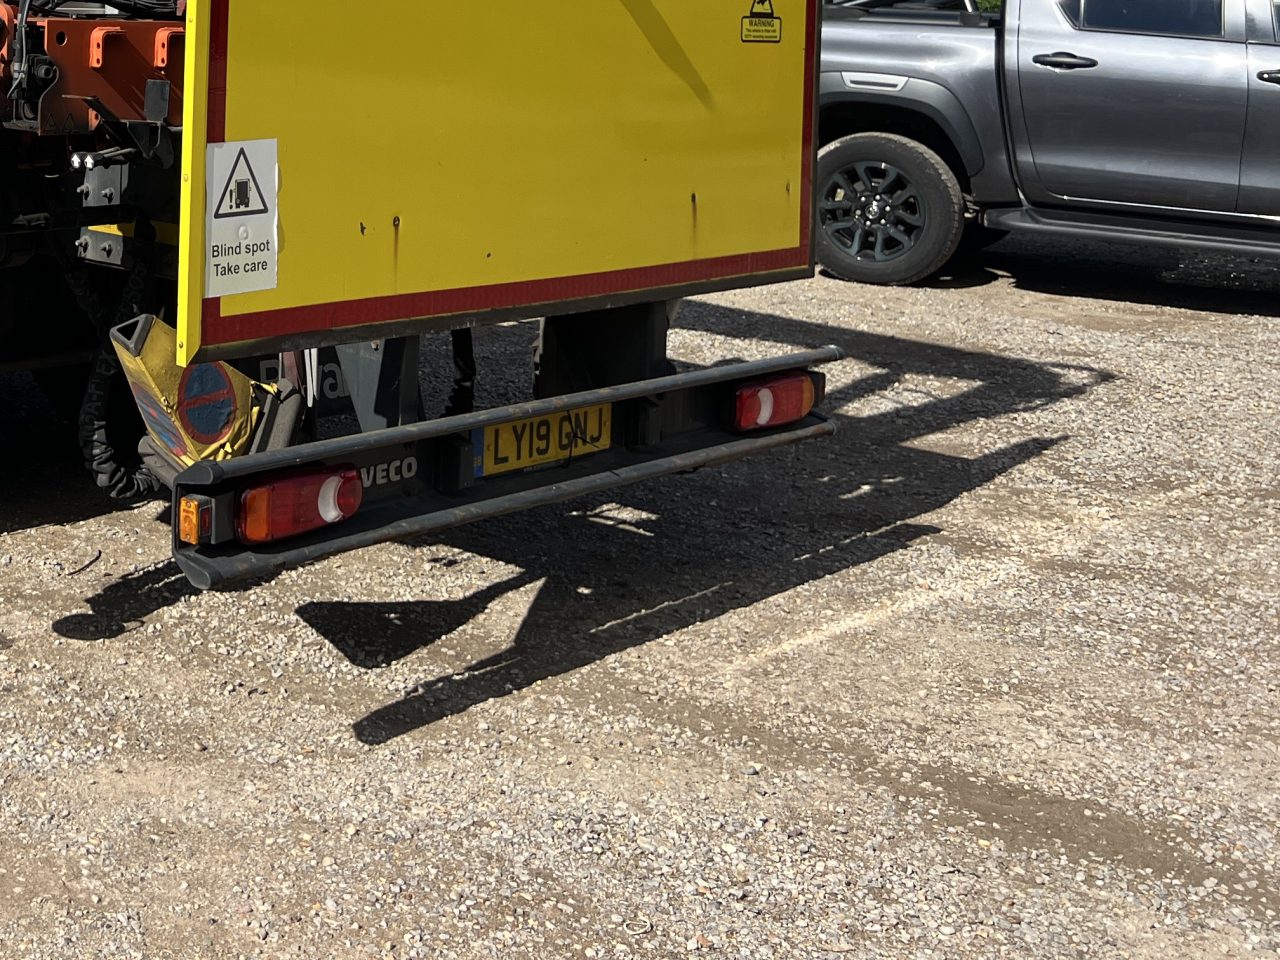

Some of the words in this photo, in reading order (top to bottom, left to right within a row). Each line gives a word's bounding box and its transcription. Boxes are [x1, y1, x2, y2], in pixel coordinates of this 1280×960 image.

[212, 242, 241, 258] Blind
[245, 240, 270, 256] spot
[213, 262, 240, 277] Take
[243, 260, 268, 273] care
[494, 419, 550, 465] LY19
[558, 408, 603, 450] GNJ
[360, 457, 418, 488] VECO
